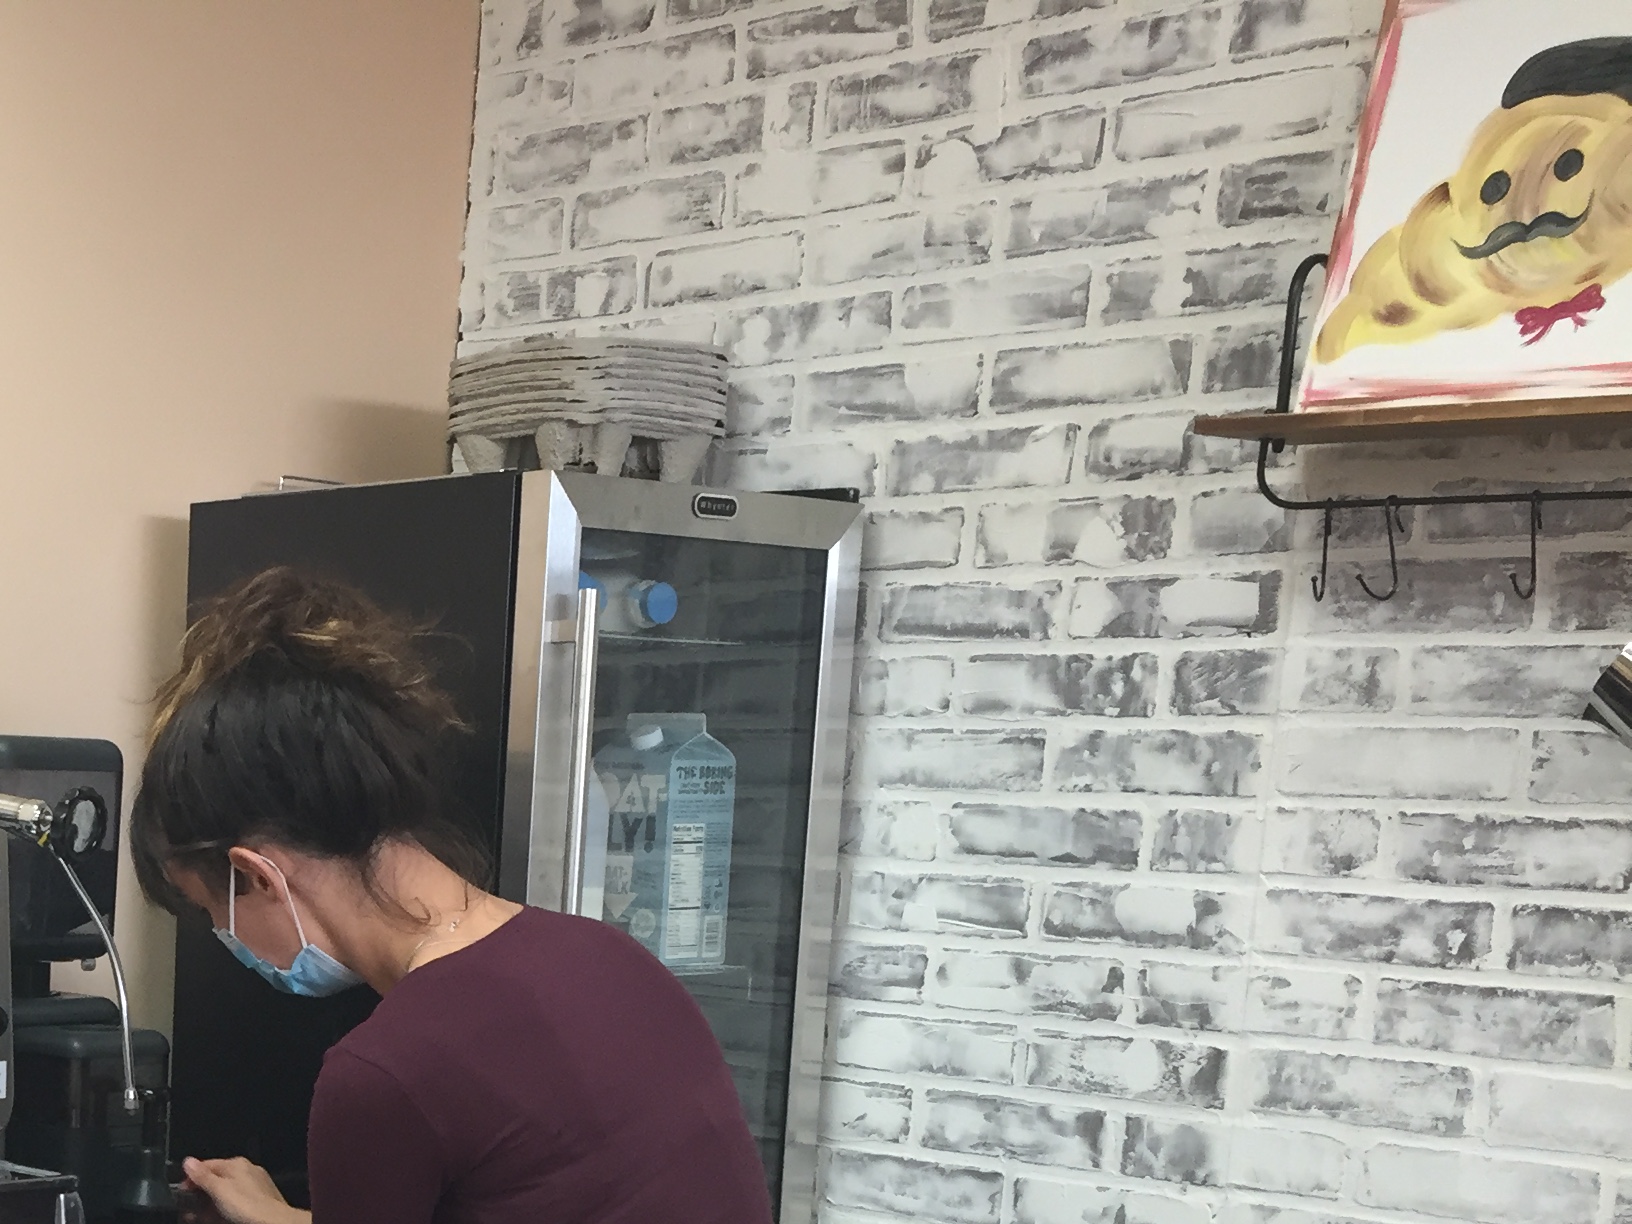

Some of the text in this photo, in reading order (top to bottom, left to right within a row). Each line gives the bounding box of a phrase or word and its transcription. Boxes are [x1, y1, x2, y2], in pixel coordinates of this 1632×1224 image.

[676, 766, 734, 780] THE BORING
[703, 781, 726, 795] SIDE
